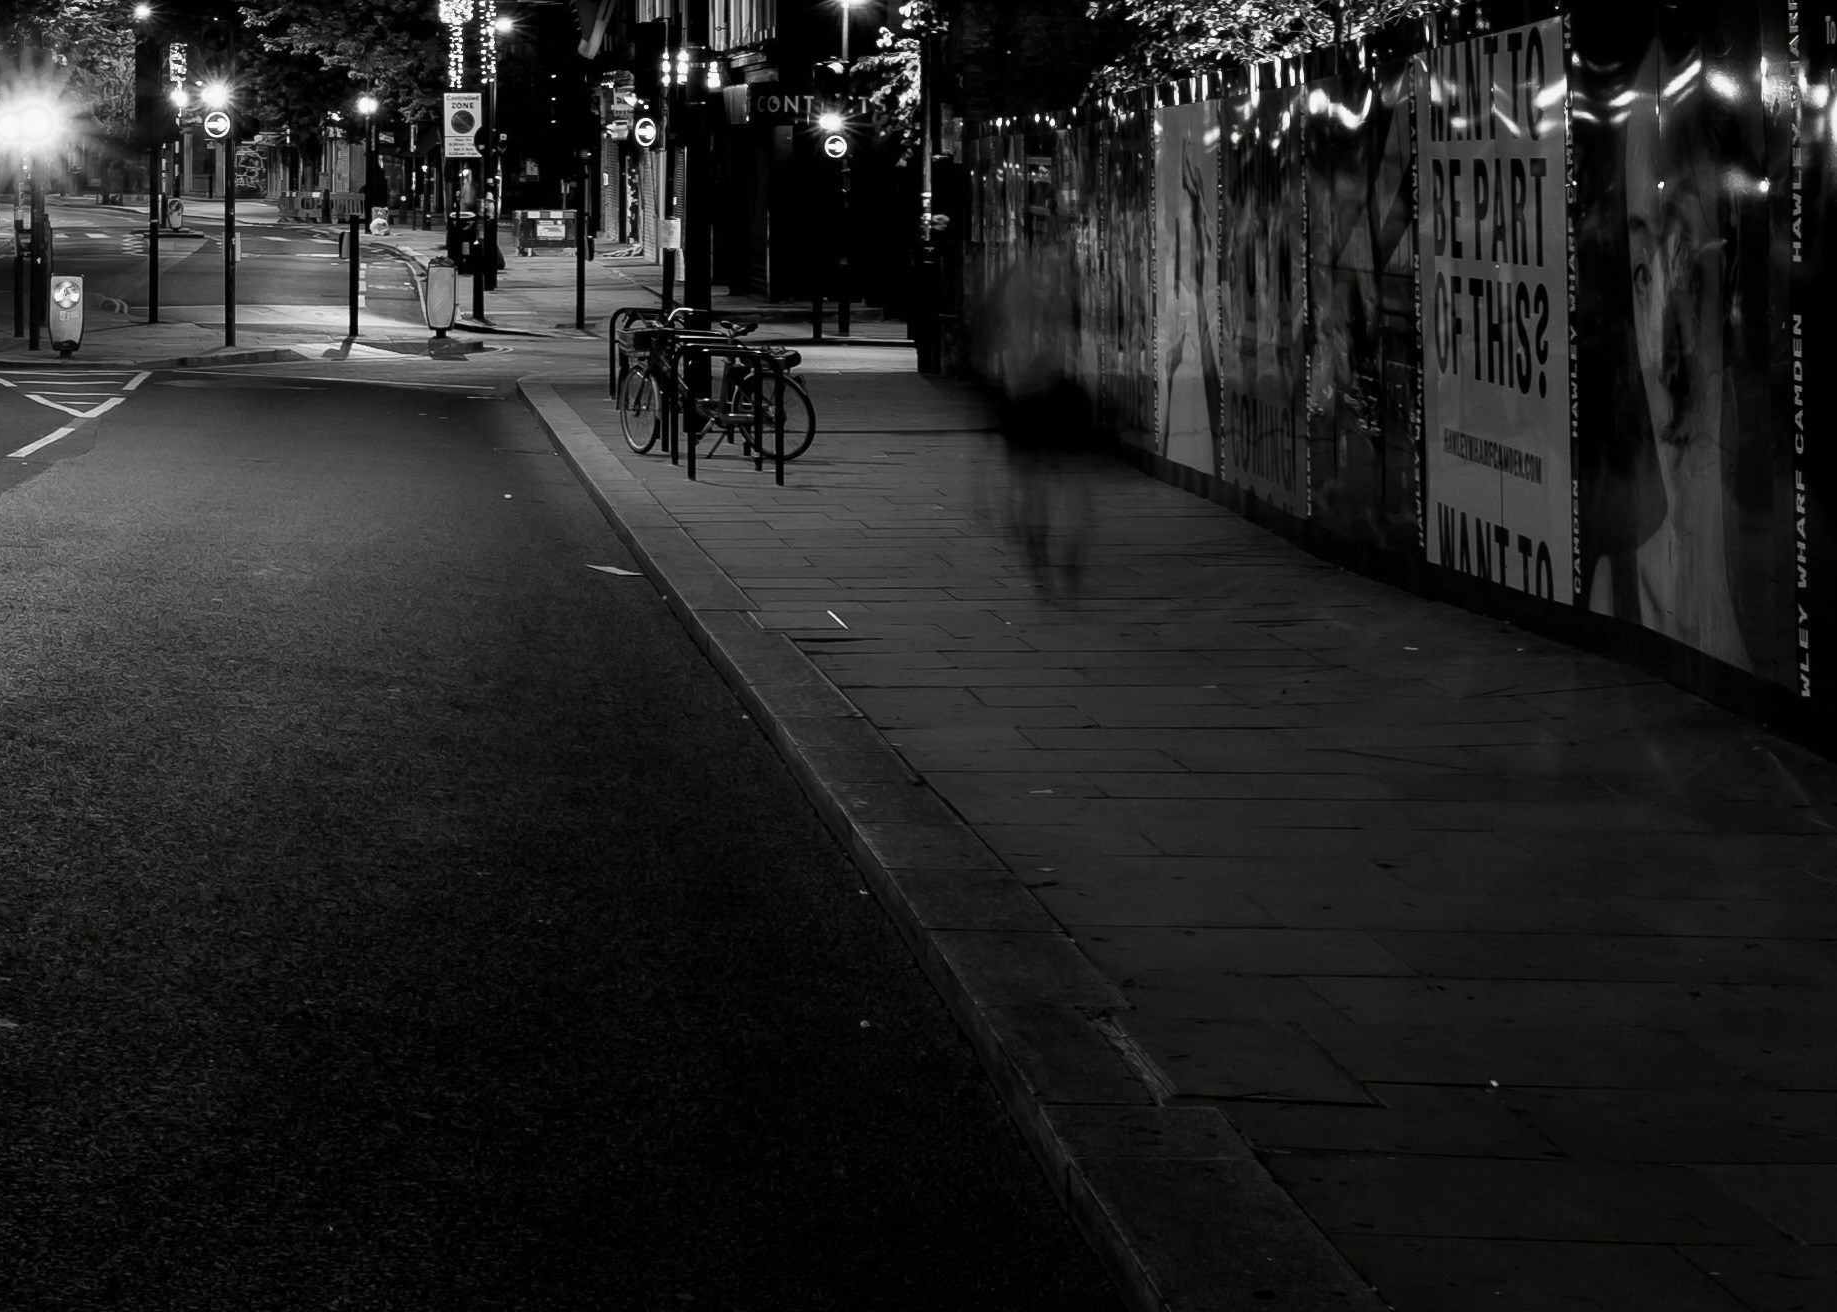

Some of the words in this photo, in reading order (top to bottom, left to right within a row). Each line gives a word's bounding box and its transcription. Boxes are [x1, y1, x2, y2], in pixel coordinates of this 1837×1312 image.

[1431, 158, 1463, 260] BE
[1474, 157, 1548, 268] PART
[1434, 271, 1463, 376] OF
[1469, 278, 1550, 399] THIS?
[1790, 312, 1805, 456] CAMDEN
[1793, 469, 1810, 589] WHARF
